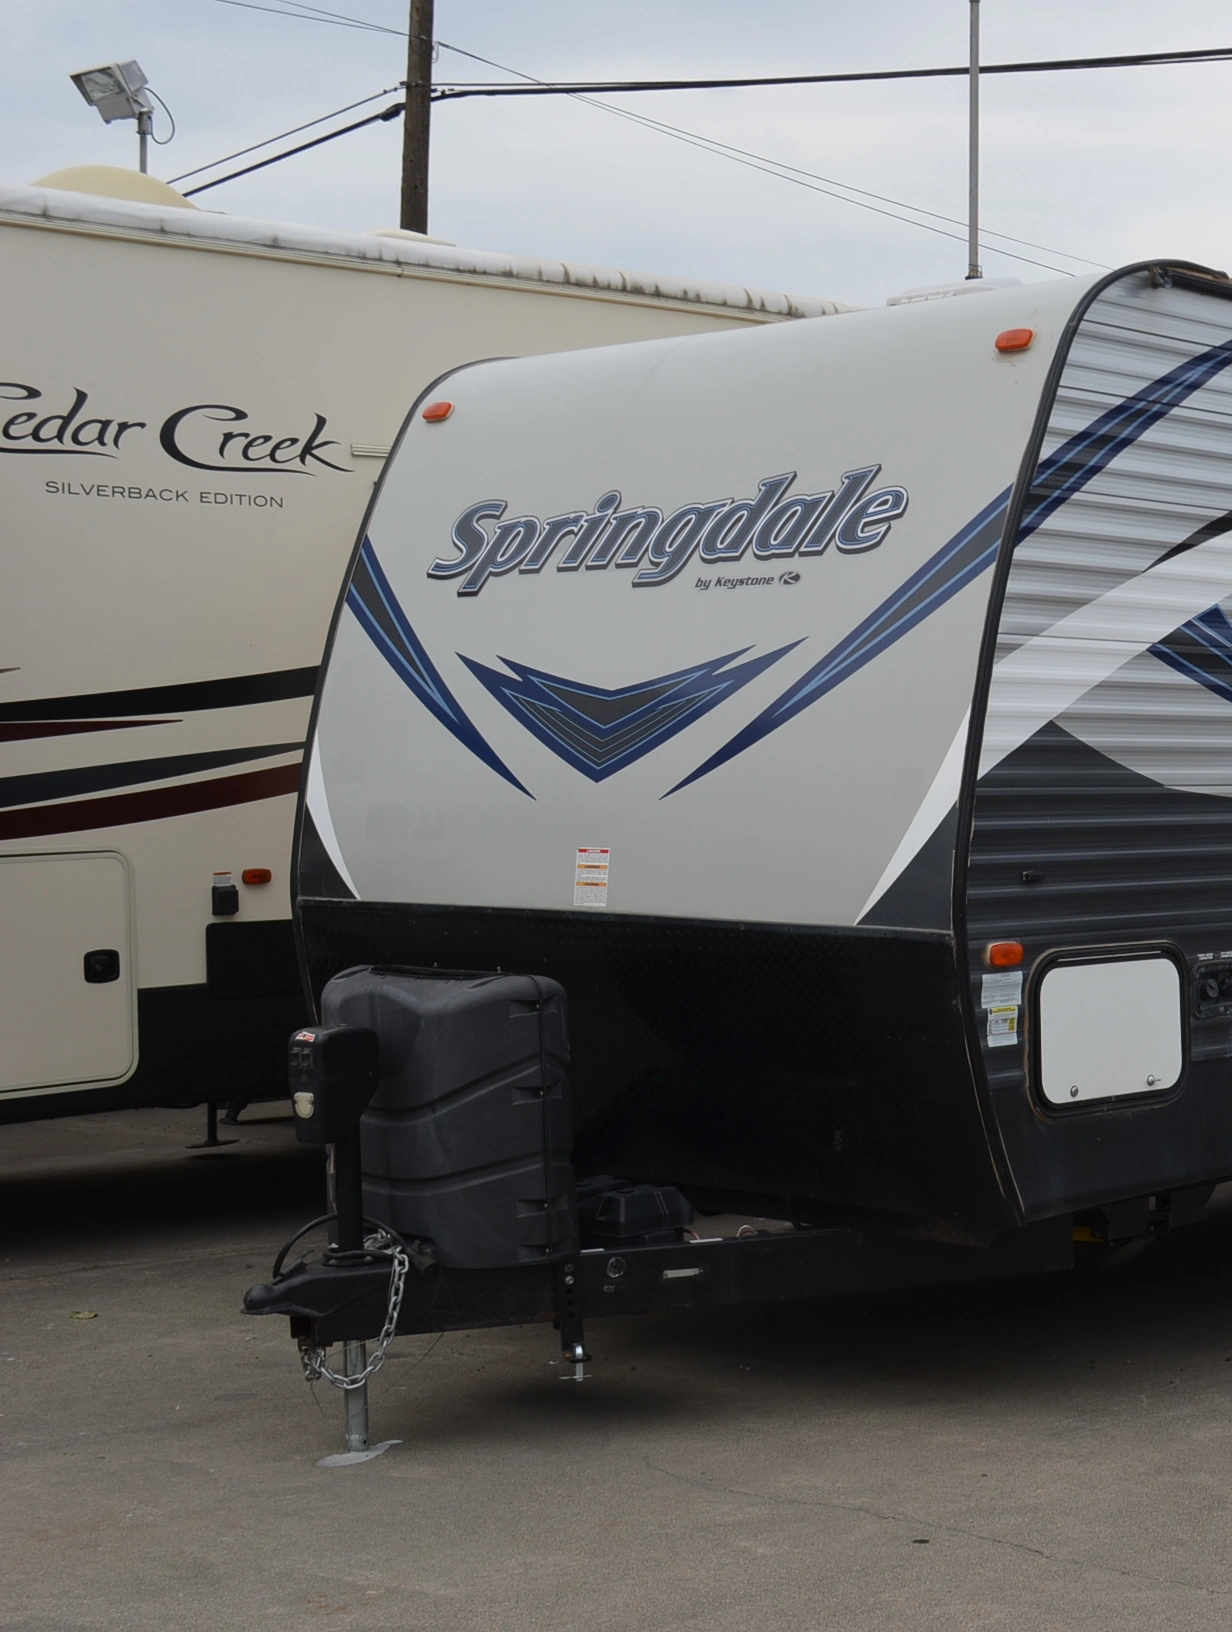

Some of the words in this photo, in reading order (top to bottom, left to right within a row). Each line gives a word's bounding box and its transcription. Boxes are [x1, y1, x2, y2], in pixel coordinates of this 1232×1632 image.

[160, 404, 355, 477] Creek
[45, 480, 190, 503] SILVERBACK
[200, 492, 284, 508] EDITION
[427, 464, 909, 597] Springdale
[695, 578, 712, 590] by
[714, 576, 774, 590] Keystone
